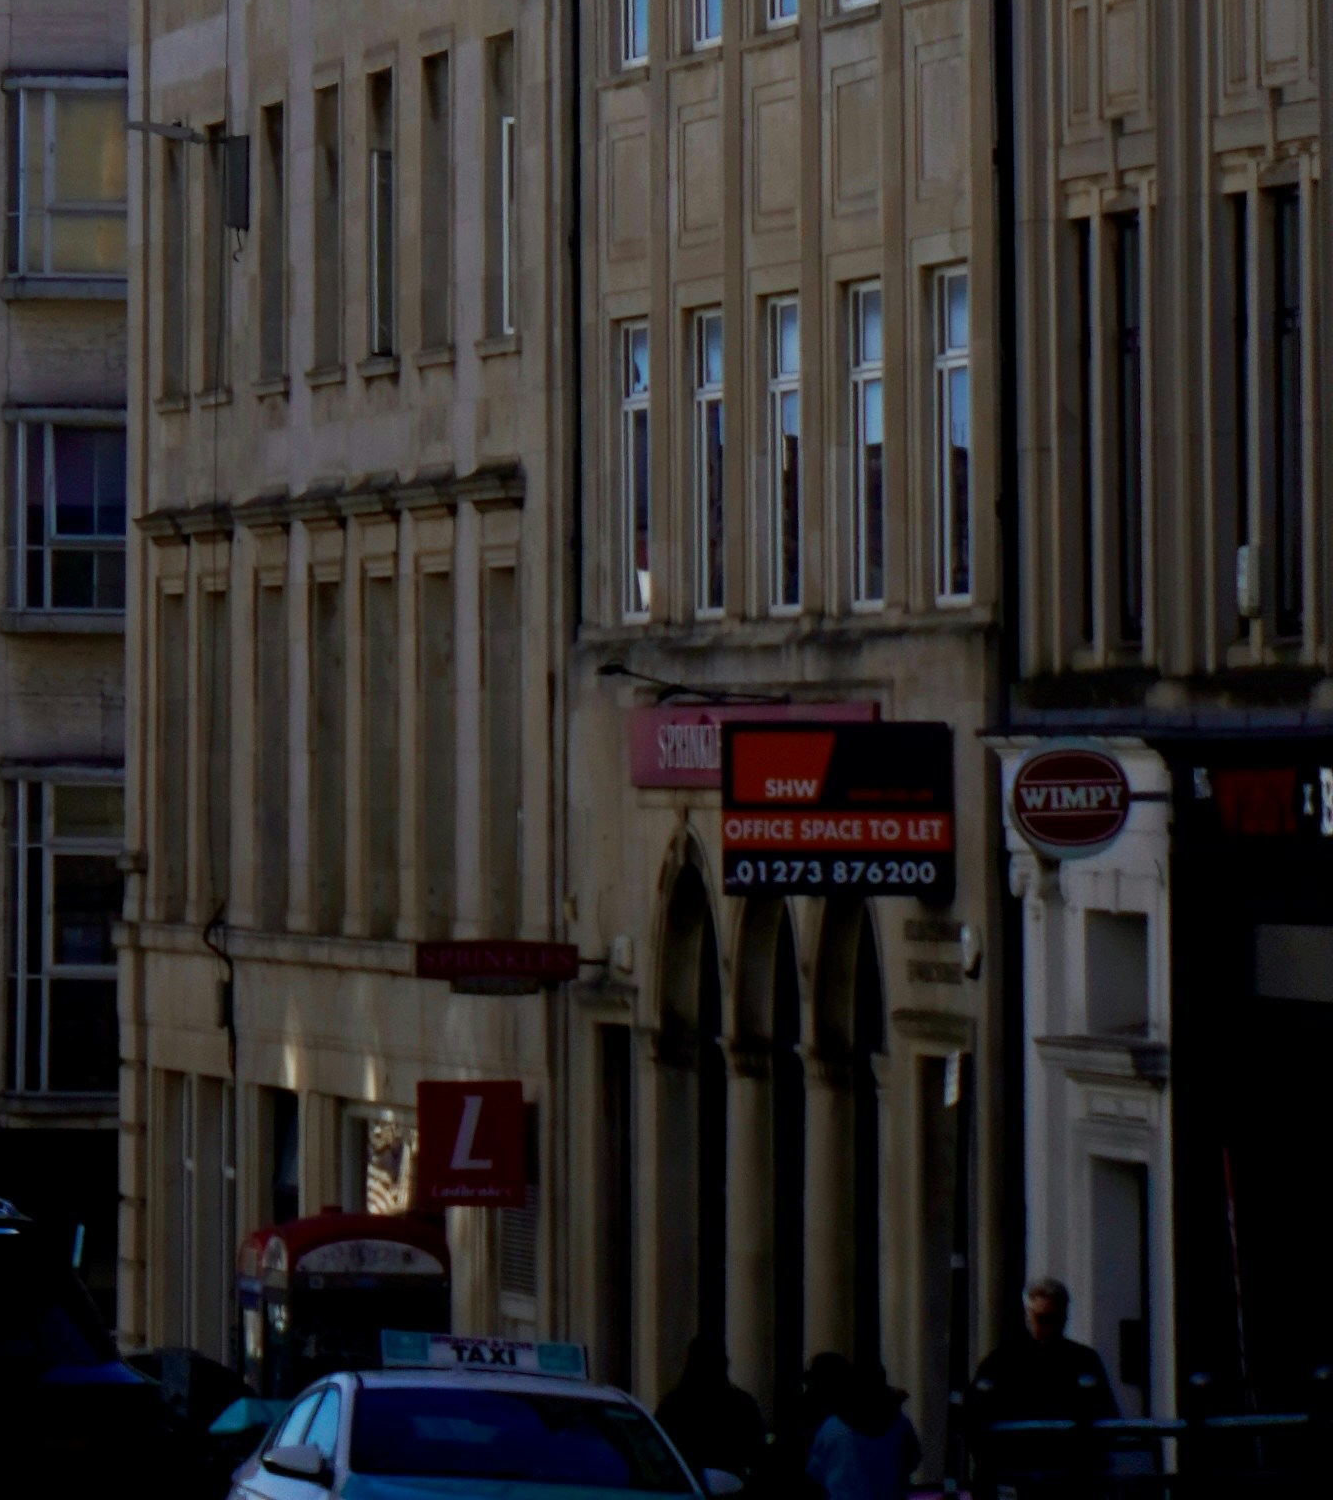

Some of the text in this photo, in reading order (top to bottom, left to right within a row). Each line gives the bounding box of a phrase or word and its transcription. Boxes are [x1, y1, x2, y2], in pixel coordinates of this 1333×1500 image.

[763, 777, 820, 800] SHW
[1019, 784, 1124, 811] WIMPY
[724, 818, 944, 842] OFFICE SPACE TO LET
[735, 859, 825, 886] 01273
[832, 859, 937, 886] 876200
[421, 948, 573, 972] SPRINKLES
[448, 1093, 494, 1171] L
[452, 1345, 517, 1366] TAXI
